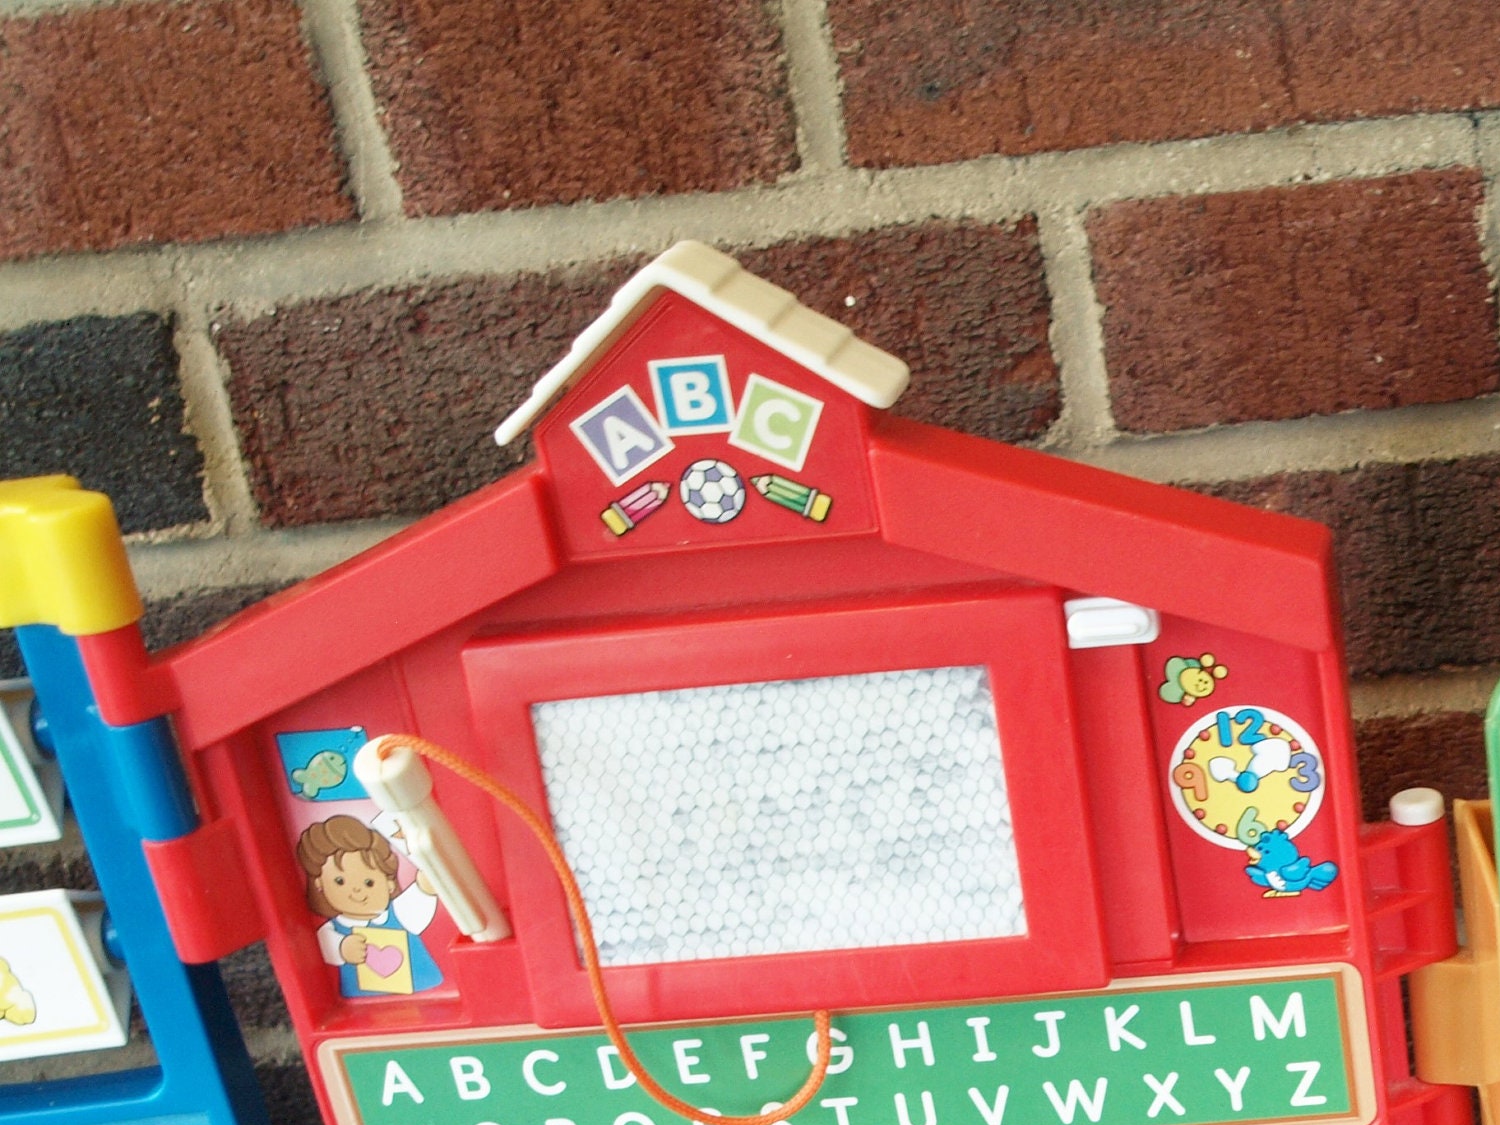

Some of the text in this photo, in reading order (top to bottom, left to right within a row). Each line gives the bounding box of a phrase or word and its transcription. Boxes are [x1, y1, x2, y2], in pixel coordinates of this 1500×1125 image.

[1216, 708, 1266, 748] 12
[1173, 762, 1208, 801] 9
[1289, 752, 1321, 792] 3
[382, 992, 1307, 1106] A B C D E F G H I J K L M
[1043, 1077, 1108, 1125] W
[1143, 1072, 1186, 1118] X
[1214, 1066, 1251, 1111] Y
[1286, 1061, 1328, 1107] Z
